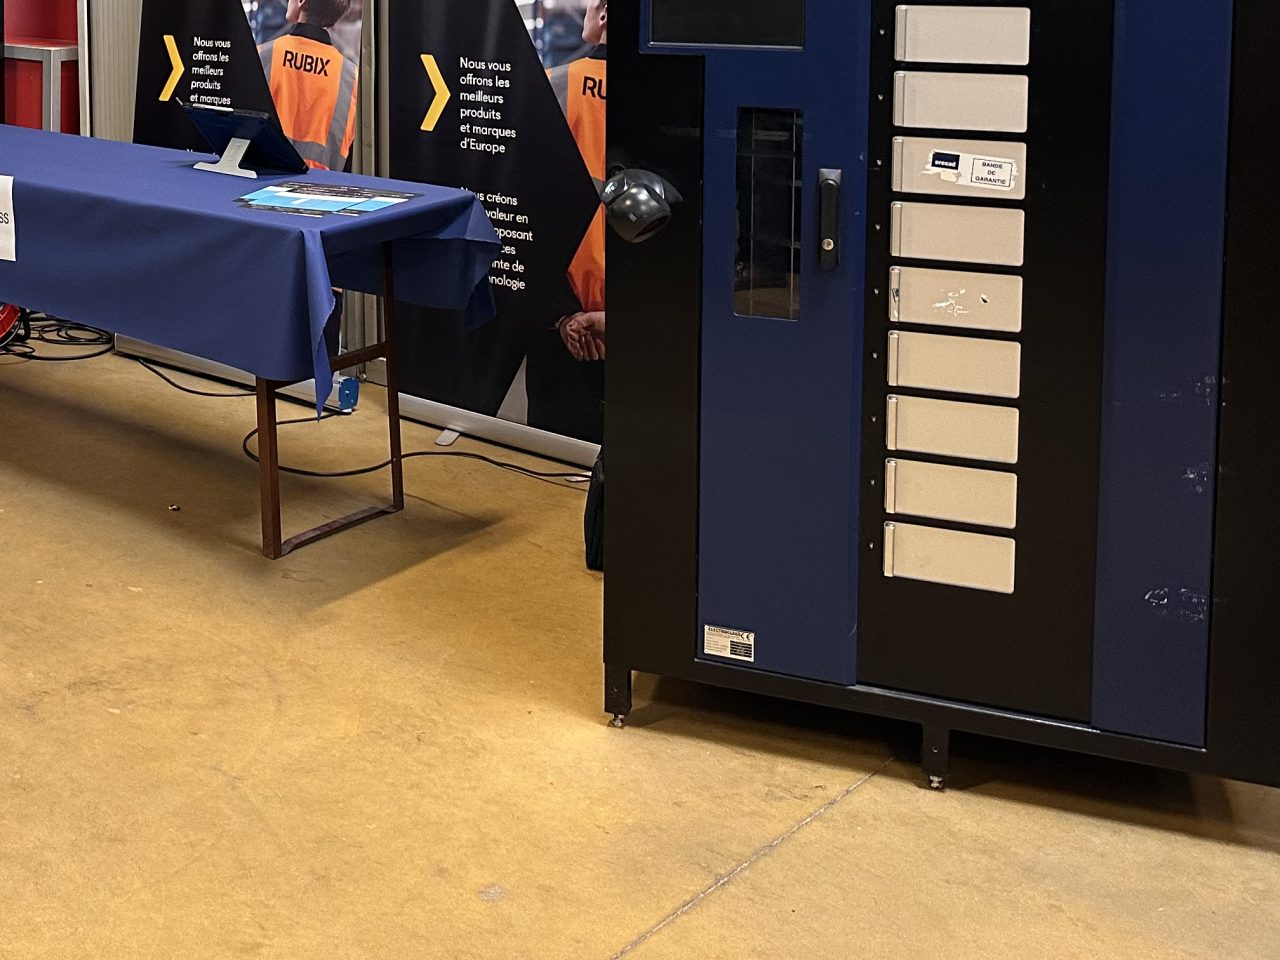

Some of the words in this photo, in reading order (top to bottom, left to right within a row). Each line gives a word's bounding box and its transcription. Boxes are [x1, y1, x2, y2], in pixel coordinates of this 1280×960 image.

[193, 36, 214, 48] Nous
[214, 40, 231, 49] vous
[192, 51, 218, 62] offrons
[218, 52, 230, 62] les
[282, 50, 331, 77] RUBIX
[191, 65, 224, 76] meilleurs
[459, 56, 486, 70] Nous
[487, 62, 511, 72] vous
[190, 80, 221, 90] produits
[459, 73, 493, 87] offrons
[495, 75, 510, 88] les
[189, 93, 199, 102] et
[199, 95, 231, 105] marques
[459, 90, 504, 104] meilleurs
[460, 106, 502, 121] produits
[459, 123, 471, 133] et
[472, 125, 517, 140] marques
[981, 161, 1003, 170] BANDE
[486, 192, 518, 206] créons
[485, 208, 514, 222] valeur
[516, 214, 529, 224] en
[494, 227, 533, 242] oposant
[511, 260, 525, 273] de
